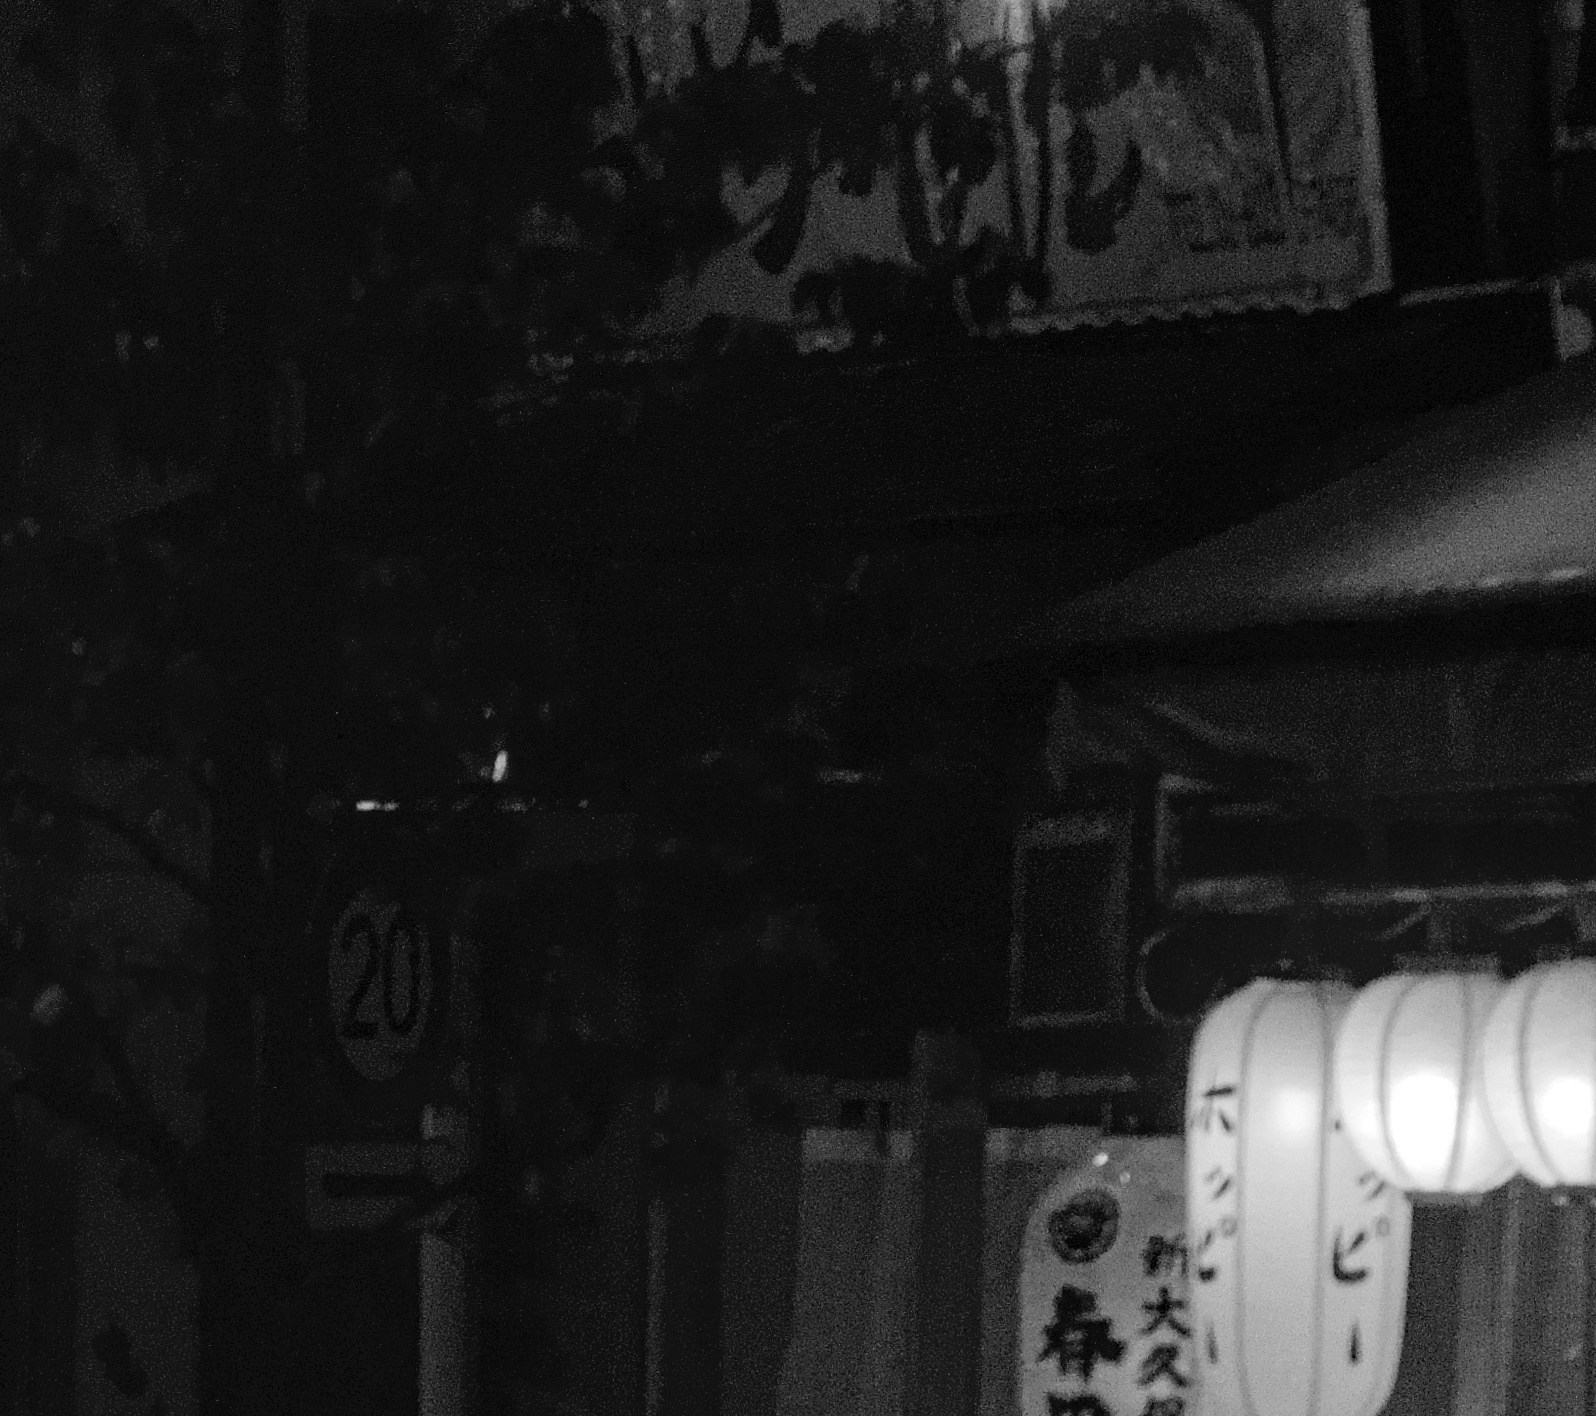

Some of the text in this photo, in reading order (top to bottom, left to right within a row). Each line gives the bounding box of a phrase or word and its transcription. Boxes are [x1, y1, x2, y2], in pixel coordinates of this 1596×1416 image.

[341, 914, 419, 1038] 20
[1331, 1120, 1391, 1364] ッピー
